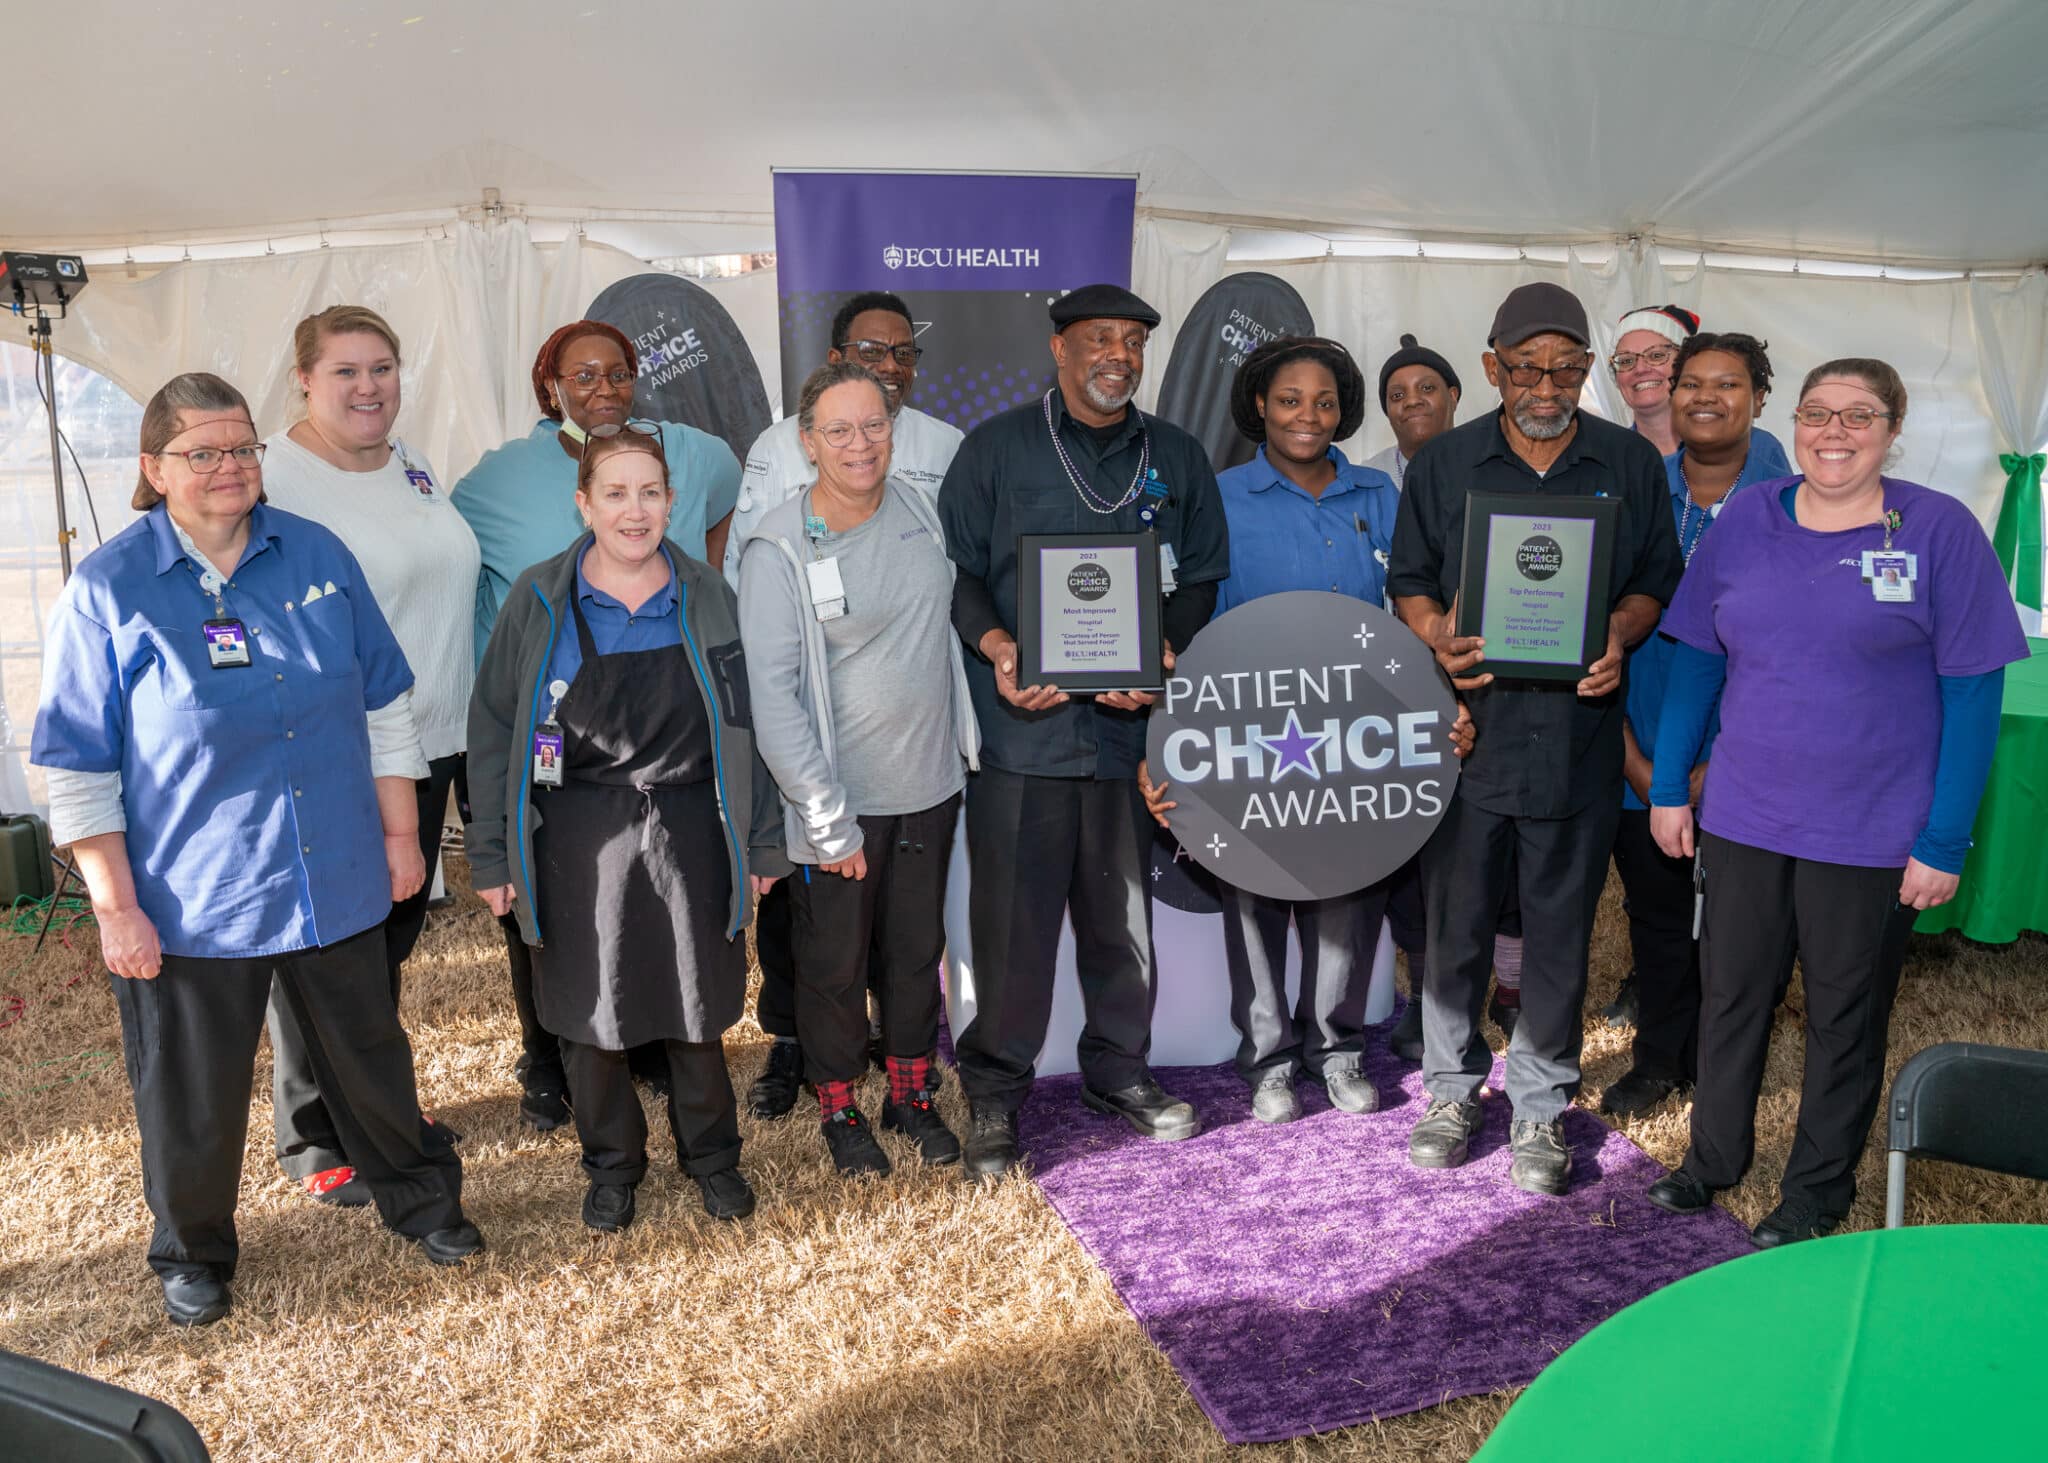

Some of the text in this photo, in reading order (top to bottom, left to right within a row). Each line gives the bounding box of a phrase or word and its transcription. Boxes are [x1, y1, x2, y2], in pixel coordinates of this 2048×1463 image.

[904, 248, 1040, 268] ECU HEALTH
[1229, 308, 1278, 343] PATIENT
[651, 348, 709, 390] AWARDS
[1519, 545, 1550, 553] PATIENT
[1518, 552, 1560, 564] CHICE
[1528, 563, 1559, 571] AWARDS
[1069, 575, 1108, 586] CHICE
[1509, 587, 1565, 598] Top Performing
[1082, 608, 1117, 616] Improved
[1529, 639, 1560, 647] HEALTH
[1165, 664, 1362, 715] PATIENT
[1163, 708, 1442, 784] CHICE
[1240, 779, 1443, 830] AWARDS
